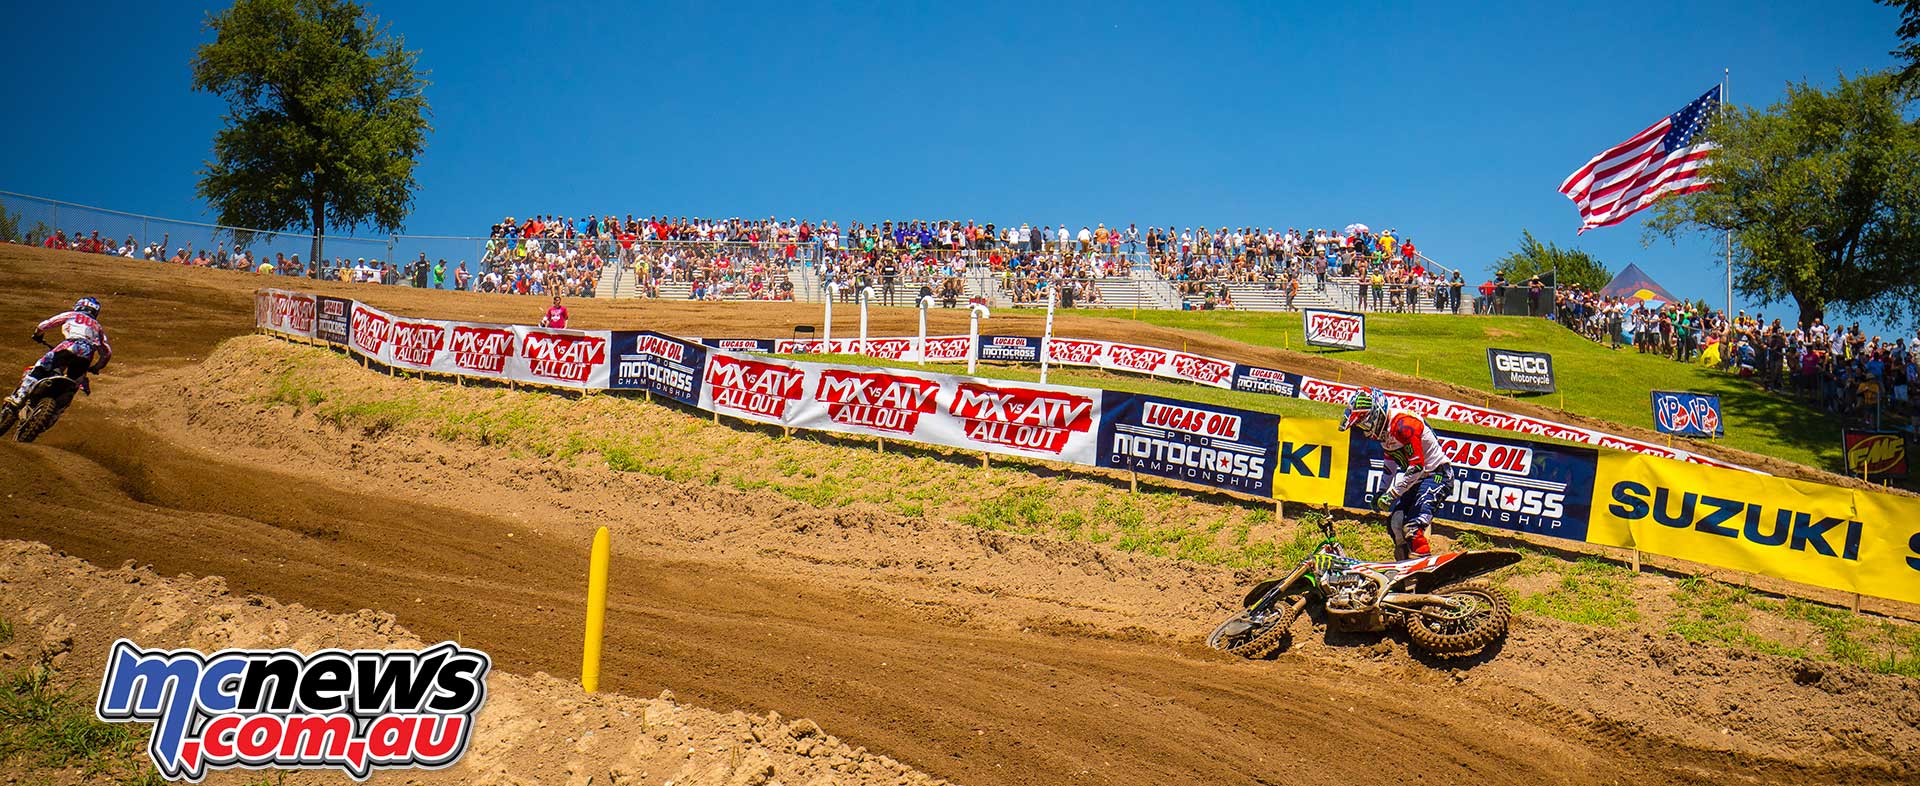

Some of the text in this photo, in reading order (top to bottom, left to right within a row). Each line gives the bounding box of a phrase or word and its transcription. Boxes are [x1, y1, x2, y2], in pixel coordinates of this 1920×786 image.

[352, 310, 369, 333] MX
[367, 320, 391, 342] ATV
[1320, 328, 1351, 340] ALL OUT
[1335, 320, 1359, 332] ATV
[355, 331, 366, 347] ALL
[365, 336, 380, 352] OUT
[391, 325, 415, 345] MX
[414, 328, 445, 350] ATV
[450, 331, 480, 353] MX
[479, 333, 514, 355] ATV
[639, 336, 682, 361] LUCAS OIL
[881, 341, 909, 351] ATV
[995, 338, 1025, 346] LUCAS OIL
[396, 347, 432, 364] ALL OUT
[523, 336, 560, 359] MX
[562, 340, 605, 364] ATV
[927, 349, 964, 358] ALL OUT
[983, 347, 1035, 357] MOTOCROSS
[1053, 352, 1090, 362] ALL OUT
[1071, 344, 1101, 355] ATV
[1109, 347, 1135, 360] MX
[1135, 351, 1165, 364] ATV
[458, 353, 501, 371] ALL OUT
[534, 361, 586, 379] ALL OUT
[648, 355, 669, 367] PRO
[1116, 358, 1153, 370] ALL OUT
[1173, 356, 1200, 369] MX
[1199, 362, 1230, 378] ATV
[1496, 354, 1548, 374] GEICO
[619, 361, 693, 392] MOTOCROSS
[706, 360, 750, 390] MX
[751, 369, 804, 397] ATV
[1198, 371, 1218, 381] OUT
[1251, 368, 1272, 379] LUCAS
[1272, 372, 1283, 381] OIL
[618, 378, 692, 399] CHAMIONSHIP
[818, 375, 875, 405] MX
[877, 382, 939, 410] ATV
[1237, 378, 1293, 396] MOTOCROSS
[1304, 382, 1334, 397] MX
[1335, 390, 1356, 401] AT
[714, 388, 782, 415] ALL OUT
[952, 389, 1015, 421] MX
[1016, 396, 1092, 428] ATV
[1405, 398, 1440, 412] ATV
[833, 405, 913, 429] ALL OUT
[1145, 405, 1239, 438] LUCAS OIL
[1447, 406, 1479, 424] MX
[1478, 415, 1517, 430] ATV
[1658, 396, 1680, 431] VP
[1689, 397, 1710, 432] VP
[970, 422, 1061, 448] ALL OUT
[1168, 430, 1208, 447] PRO
[1519, 421, 1551, 438] MX
[1550, 429, 1590, 443] ATV
[1112, 432, 1266, 480] MOTOCROSS
[1438, 438, 1526, 472] CAS OIL
[1849, 438, 1904, 470] FMF
[1111, 455, 1263, 490] CHAMPIONSHIP
[1458, 469, 1490, 482] RO
[1366, 469, 1566, 518] MCROSS
[1364, 493, 1562, 529] CIONSHIP
[1608, 480, 1863, 561] SUZUKI
